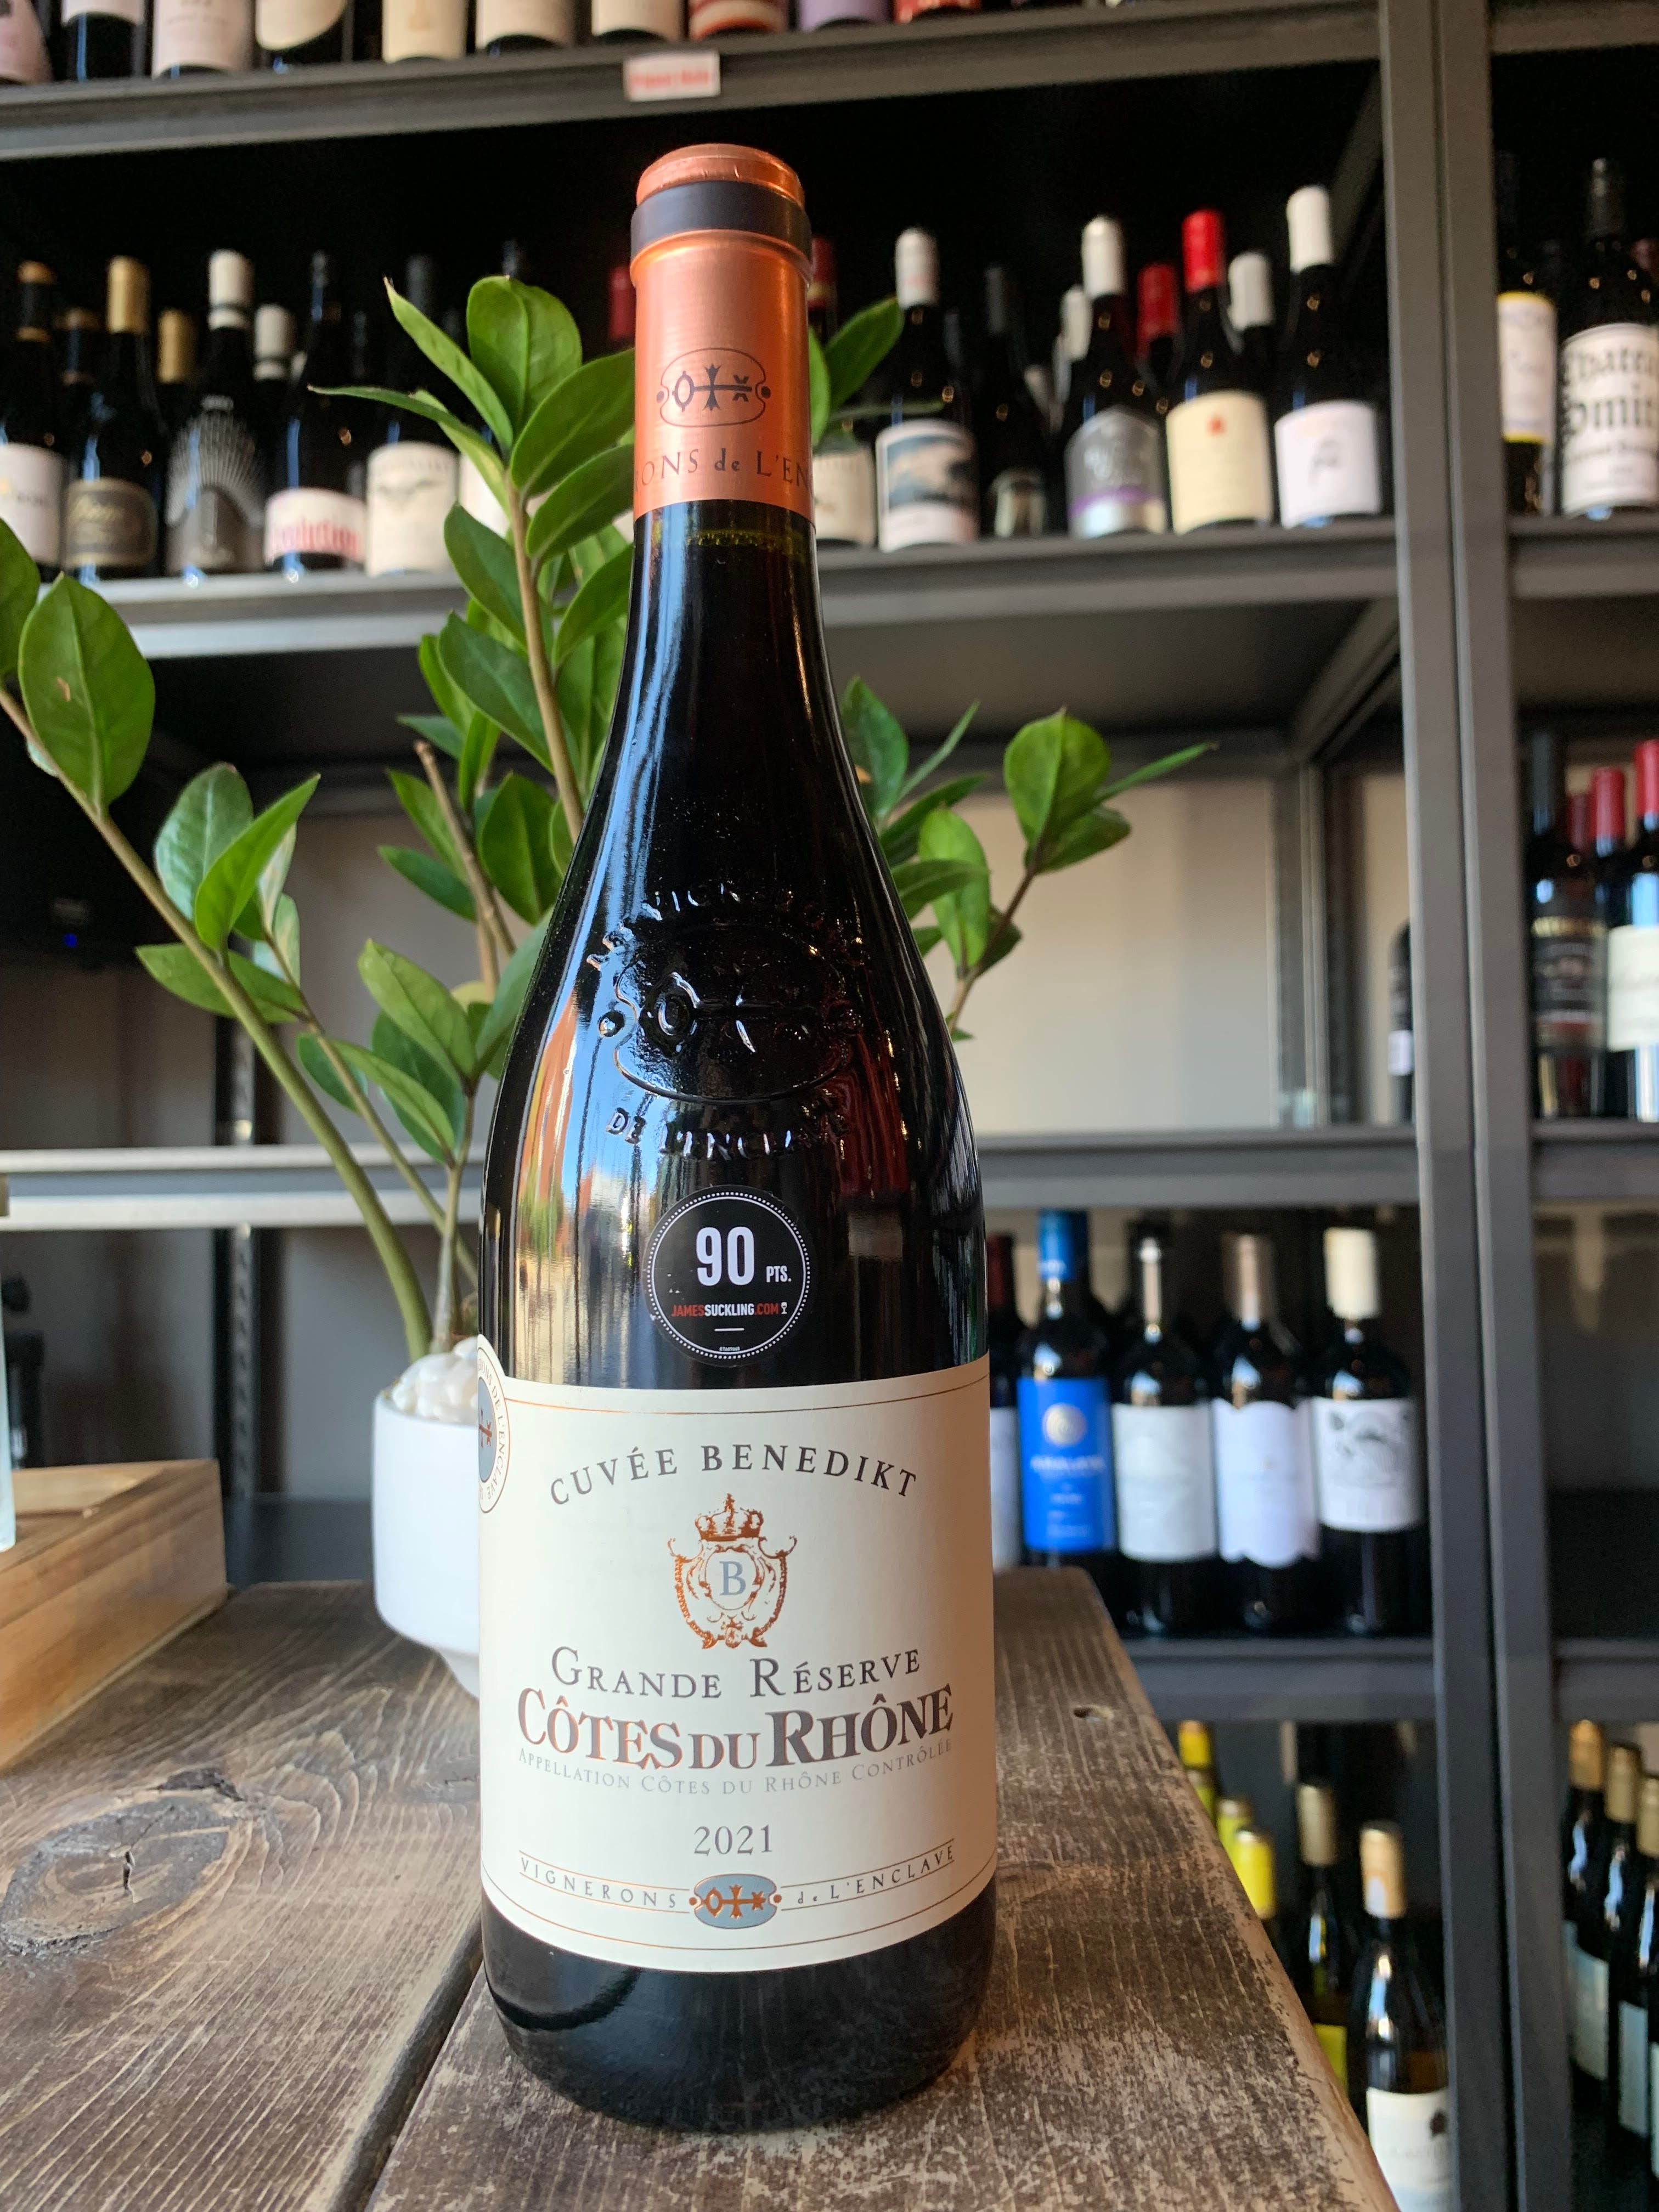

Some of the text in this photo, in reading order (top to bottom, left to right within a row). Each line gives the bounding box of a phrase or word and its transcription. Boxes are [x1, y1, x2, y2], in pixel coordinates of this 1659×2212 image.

[714, 448, 740, 471] de
[696, 1226, 792, 1286] 90 PTS.
[550, 1443, 918, 1505] CUVÉE BENEDIKT
[720, 1561, 747, 1596] B
[551, 1645, 921, 1699] GRANDE RÉSERVE
[517, 1683, 954, 1770] CÔTES DU RHÔNE
[518, 1747, 630, 1789] APPELLATION
[641, 1775, 710, 1795] CÔTES
[722, 1780, 753, 1794] DU
[765, 1770, 842, 1792] RHÔNE
[692, 1824, 774, 1856] 2021
[520, 1845, 955, 1909] VIGNERONS de L'ENCLAVE
